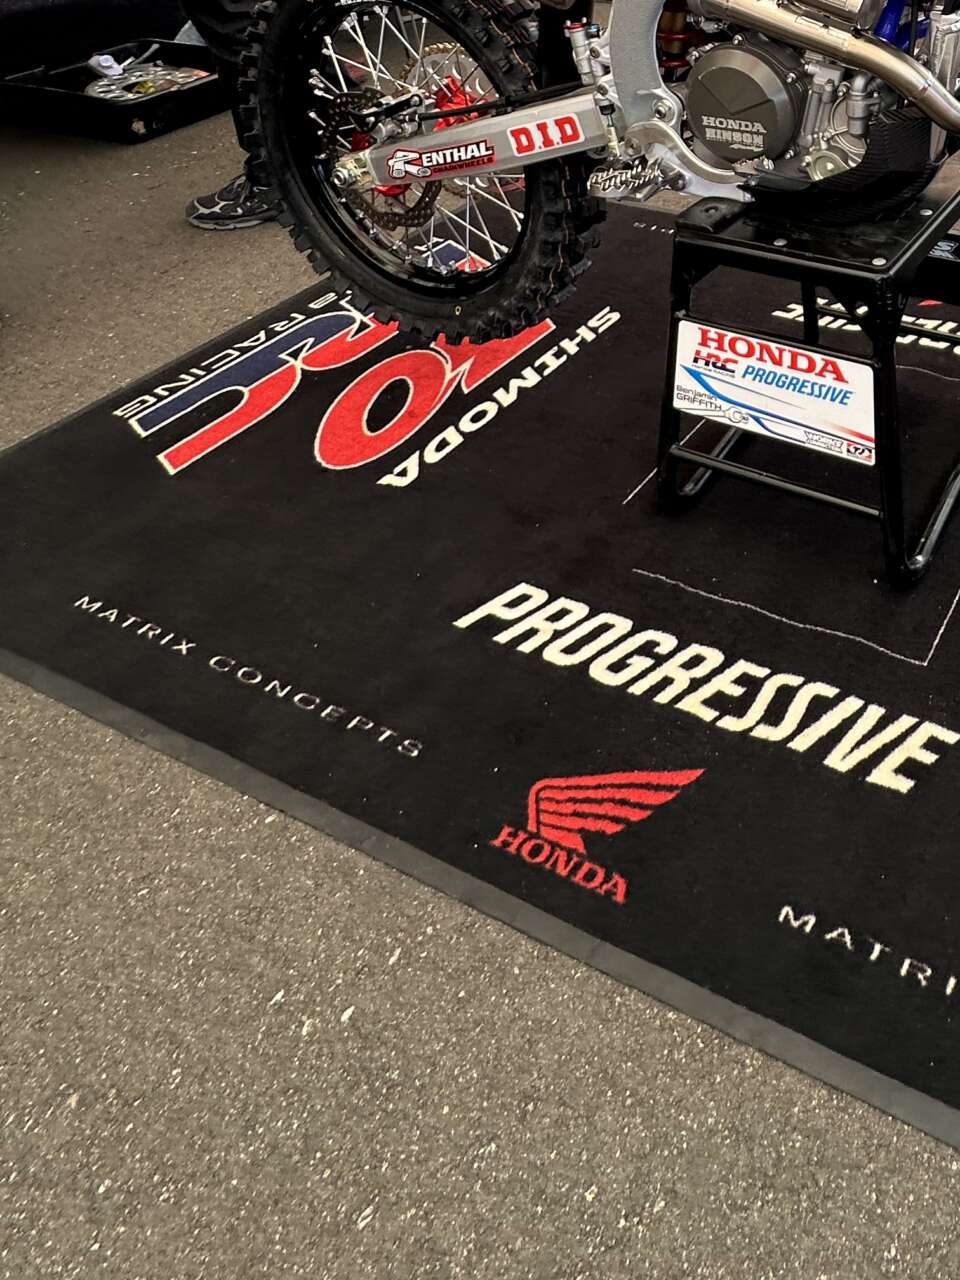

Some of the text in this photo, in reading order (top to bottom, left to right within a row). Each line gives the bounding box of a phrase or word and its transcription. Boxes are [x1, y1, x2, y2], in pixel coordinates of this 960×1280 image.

[510, 116, 582, 155] D.I.D
[701, 115, 768, 134] HONDA
[112, 312, 306, 419] RACING
[692, 349, 740, 374] HRC
[697, 326, 849, 384] HONDA
[376, 306, 622, 488] SHIMODA
[676, 384, 718, 402] Benjamin
[676, 393, 722, 412] GRIFFITH
[742, 364, 854, 407] PROGRESSIVE
[73, 594, 425, 759] MATRIX CONCEPTS
[489, 823, 630, 905] HONDA
